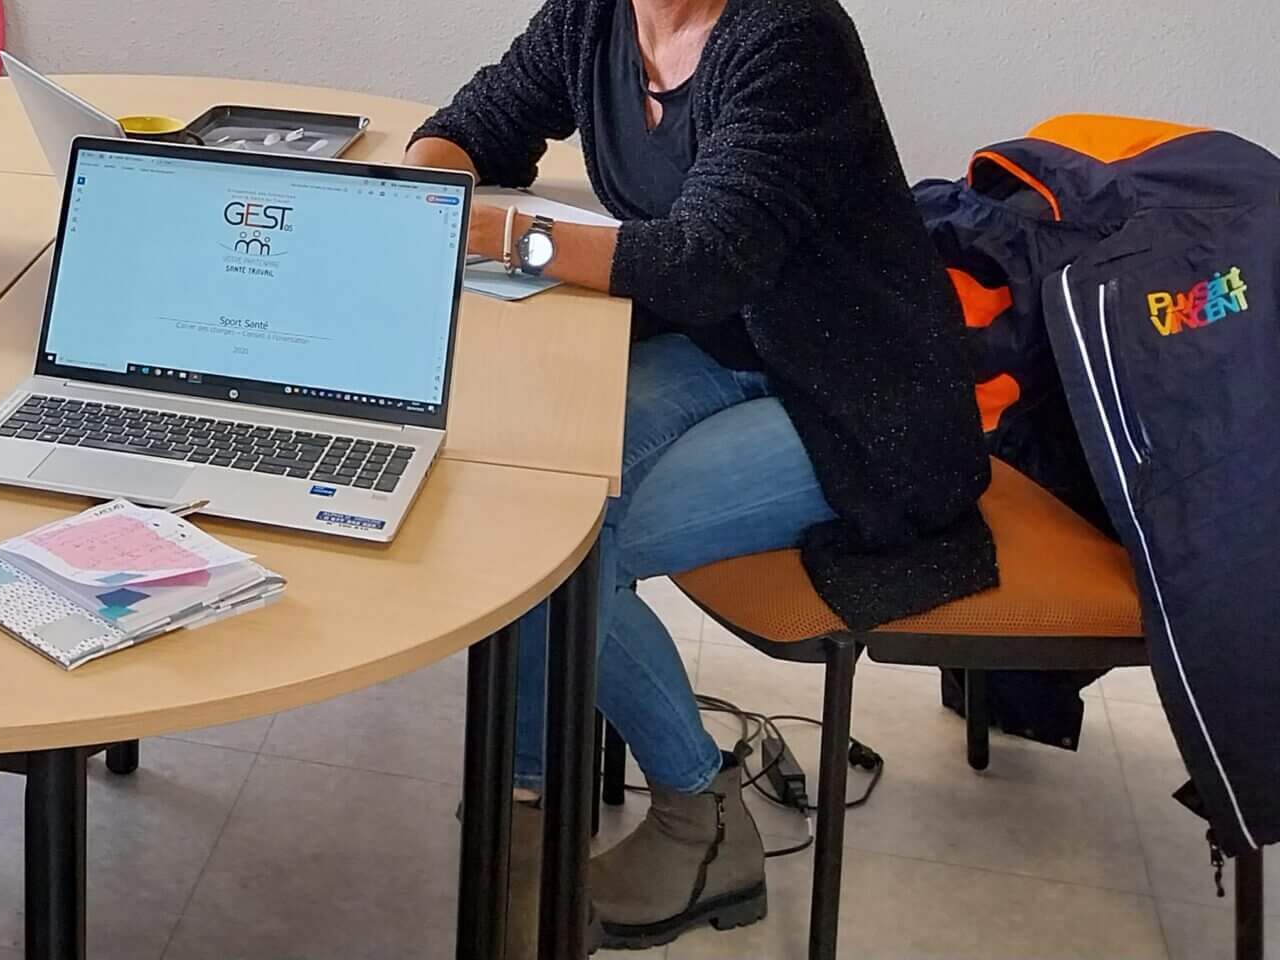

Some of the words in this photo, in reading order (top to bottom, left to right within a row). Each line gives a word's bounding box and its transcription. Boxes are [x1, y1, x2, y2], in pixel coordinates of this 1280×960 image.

[224, 202, 294, 230] GEST
[219, 315, 242, 328] Sport
[244, 318, 269, 330] Santé
[1150, 284, 1249, 337] VINCENT
